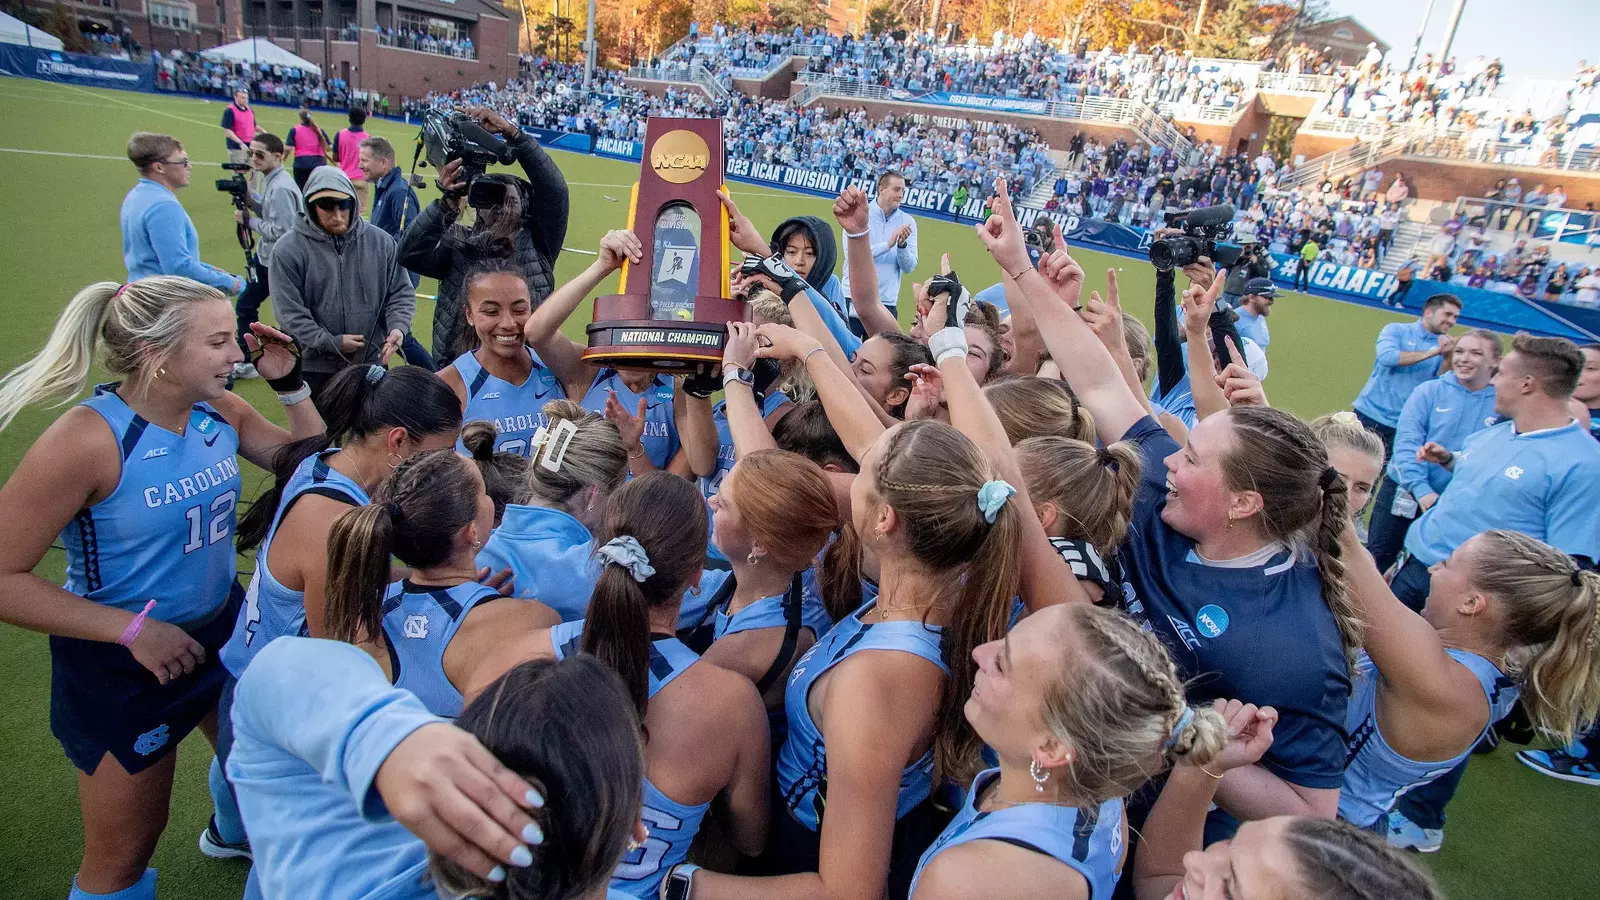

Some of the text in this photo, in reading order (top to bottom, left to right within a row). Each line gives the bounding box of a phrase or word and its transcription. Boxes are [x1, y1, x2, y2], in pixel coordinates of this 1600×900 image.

[949, 94, 1044, 112] FIELD HOCKEY CHAMPIONSHIP
[596, 138, 634, 156] #NCAAFH
[654, 153, 707, 170] NCAA
[726, 158, 750, 176] 023
[783, 167, 840, 193] DIVISION
[901, 186, 948, 211] OCKEY
[621, 331, 719, 346] NATIONAL CHAMPION
[481, 391, 501, 401] ACC
[141, 447, 168, 461] ACC
[143, 453, 240, 509] CAROLIN
[183, 488, 238, 555] 12
[1166, 614, 1202, 651] ACC
[1198, 612, 1222, 638] NCAA
